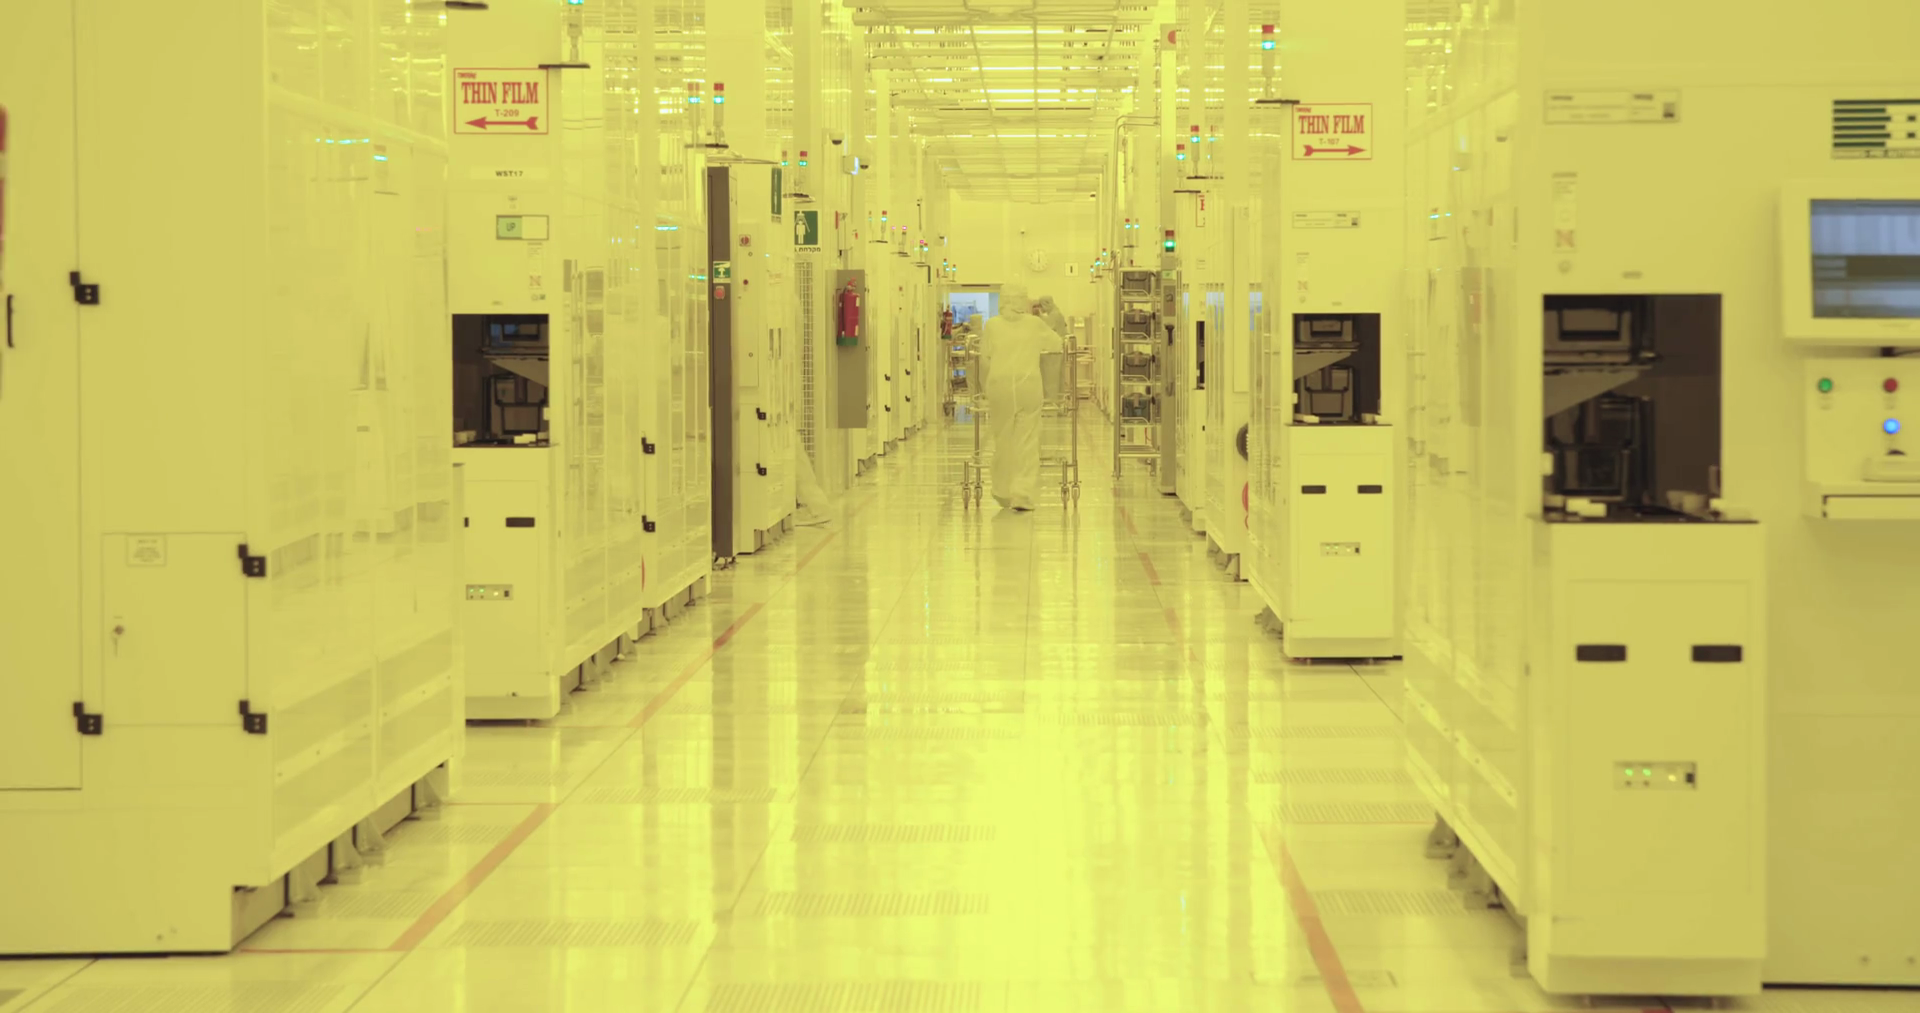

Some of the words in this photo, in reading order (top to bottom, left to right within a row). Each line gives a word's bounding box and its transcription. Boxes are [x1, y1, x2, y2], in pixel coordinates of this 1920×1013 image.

[461, 81, 497, 104] THIN
[502, 81, 539, 104] FILM
[494, 109, 520, 117] T-209
[1298, 115, 1329, 134] THIN
[1333, 115, 1365, 134] FILM
[506, 222, 517, 232] UP
